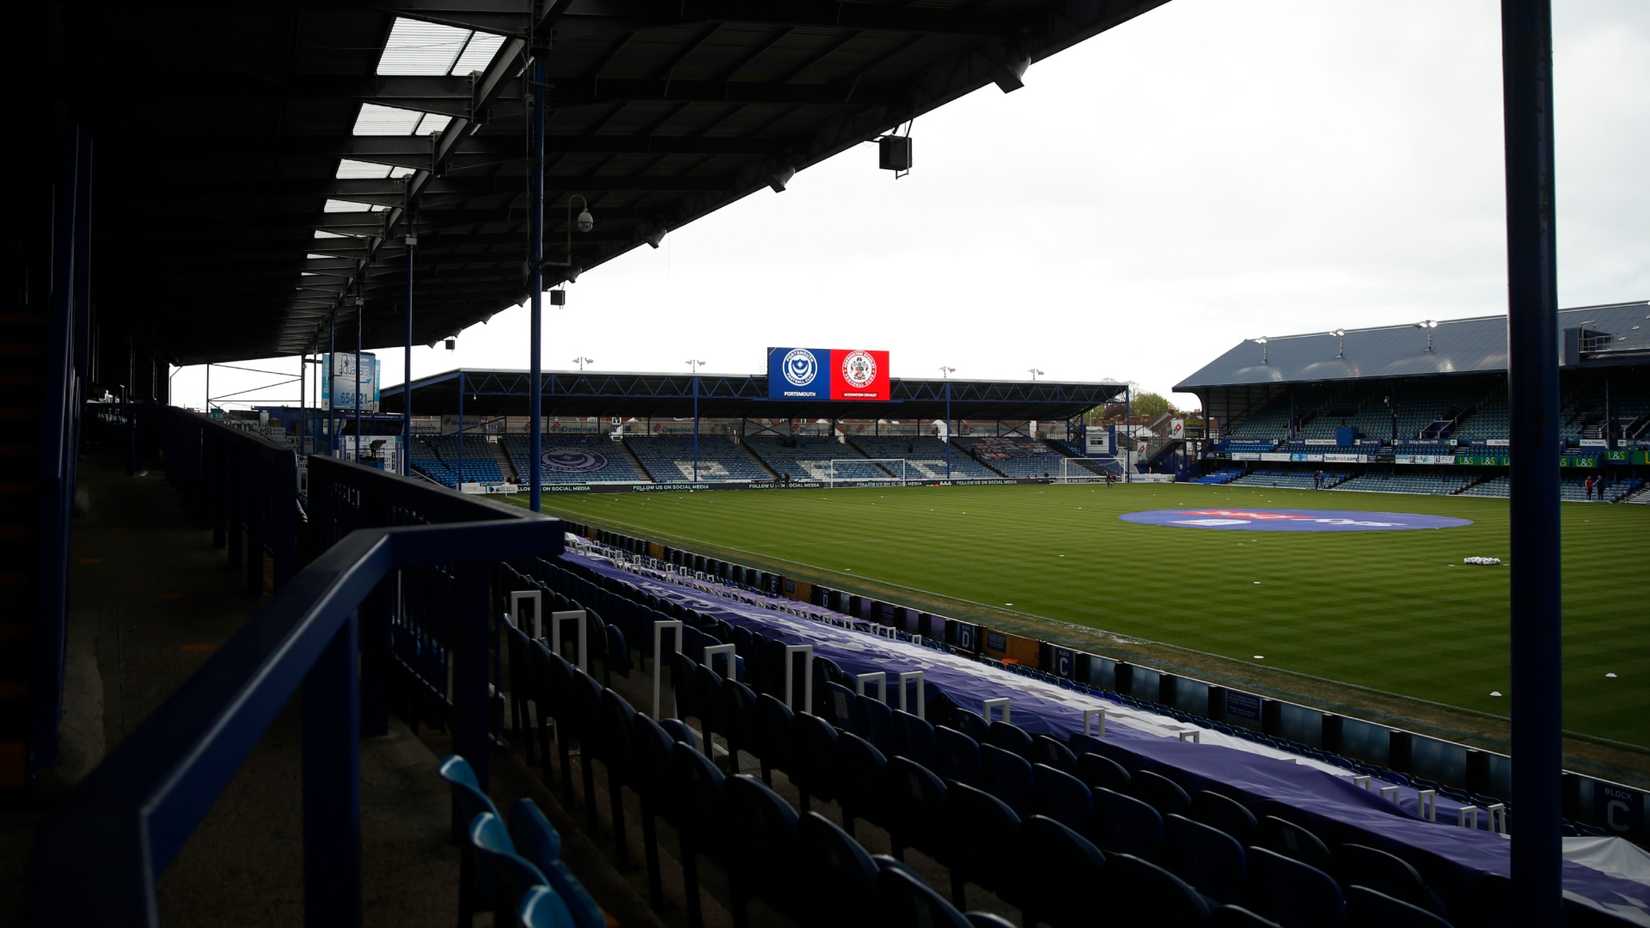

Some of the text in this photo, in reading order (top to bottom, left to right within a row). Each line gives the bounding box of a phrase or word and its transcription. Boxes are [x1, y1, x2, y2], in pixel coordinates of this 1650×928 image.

[1459, 456, 1474, 465] L&S
[1576, 457, 1593, 467] L&S
[1059, 656, 1069, 676] C
[1603, 786, 1633, 800] BLOCK
[1607, 800, 1631, 832] C
